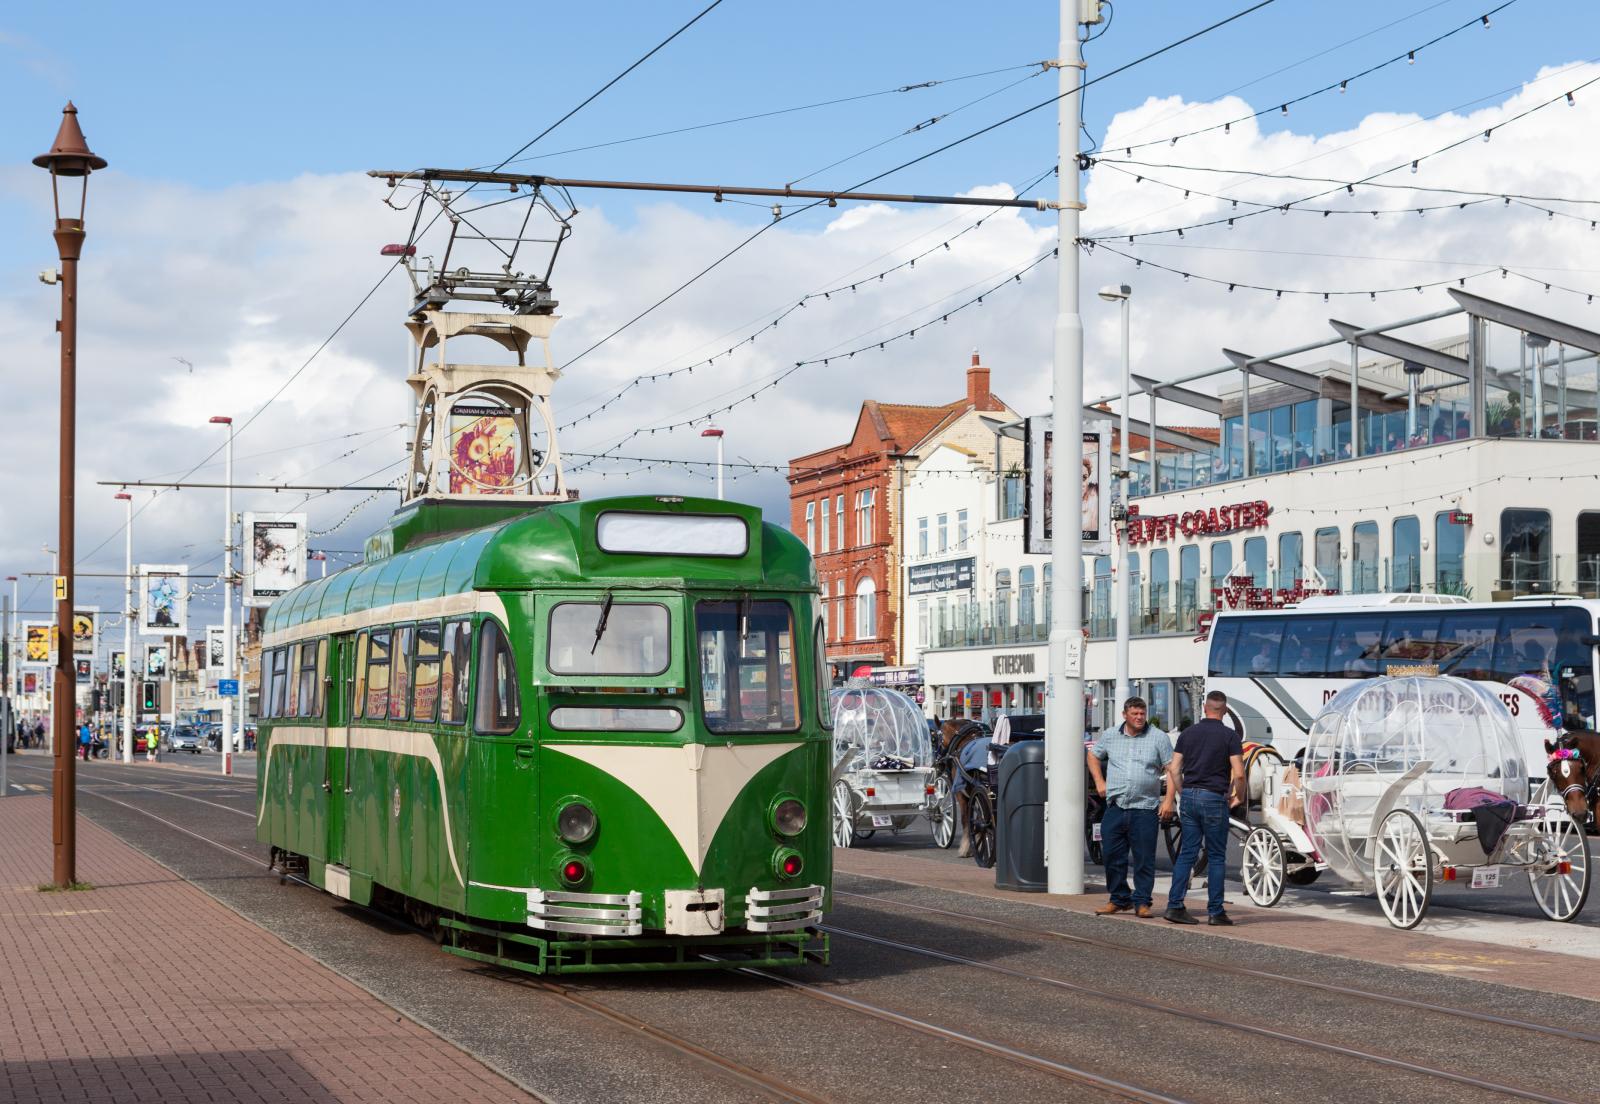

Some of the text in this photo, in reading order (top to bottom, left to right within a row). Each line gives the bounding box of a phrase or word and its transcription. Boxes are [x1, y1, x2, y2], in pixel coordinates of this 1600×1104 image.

[1180, 499, 1269, 538] COASTER
[56, 578, 65, 598] H
[992, 653, 1036, 675] WETHERSPOON
